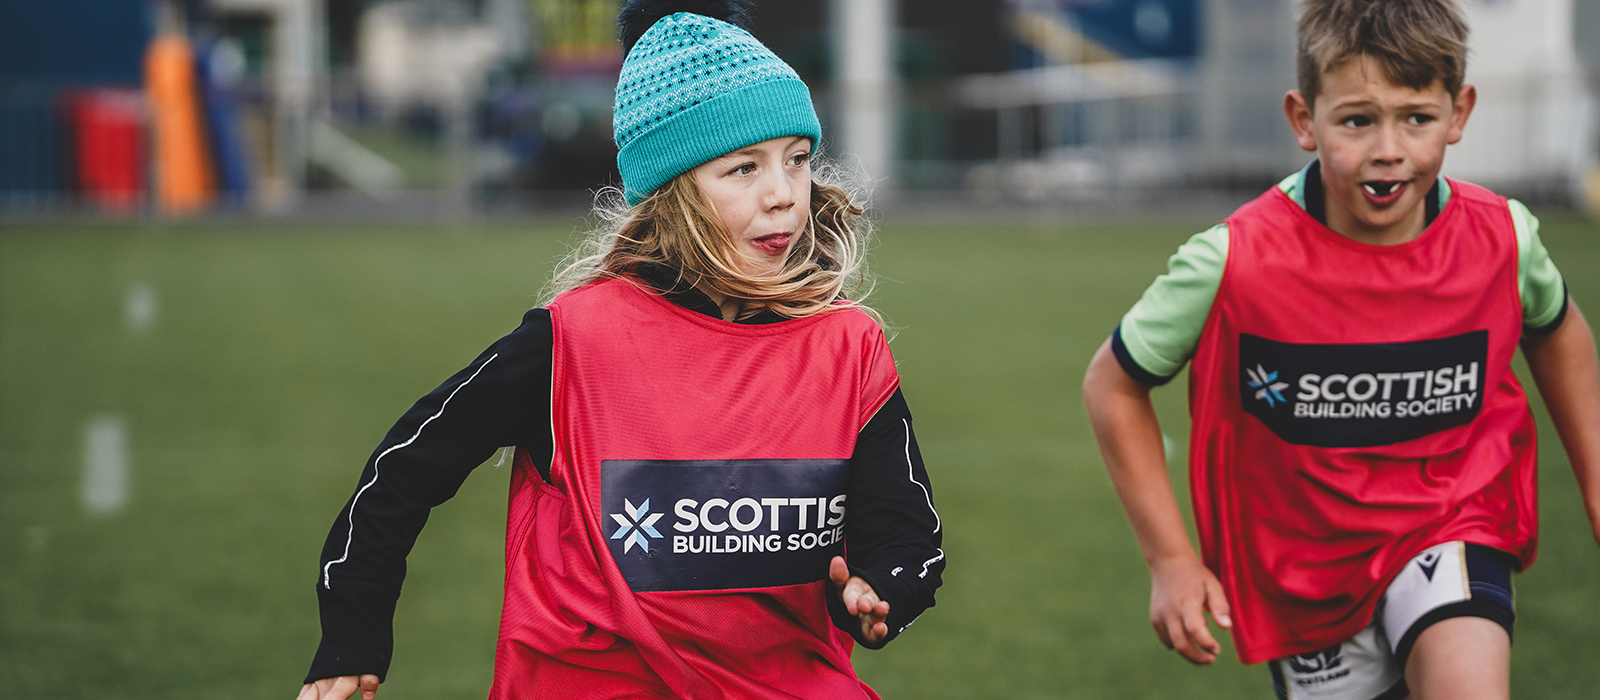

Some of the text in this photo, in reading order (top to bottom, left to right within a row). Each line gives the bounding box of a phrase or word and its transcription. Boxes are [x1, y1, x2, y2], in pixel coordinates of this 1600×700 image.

[1296, 361, 1479, 402] SCOTTISH
[1294, 392, 1477, 418] BUILDING SOCIETY
[673, 494, 847, 532] SCOTTIS
[673, 524, 845, 554] BUILDING SOCIE
